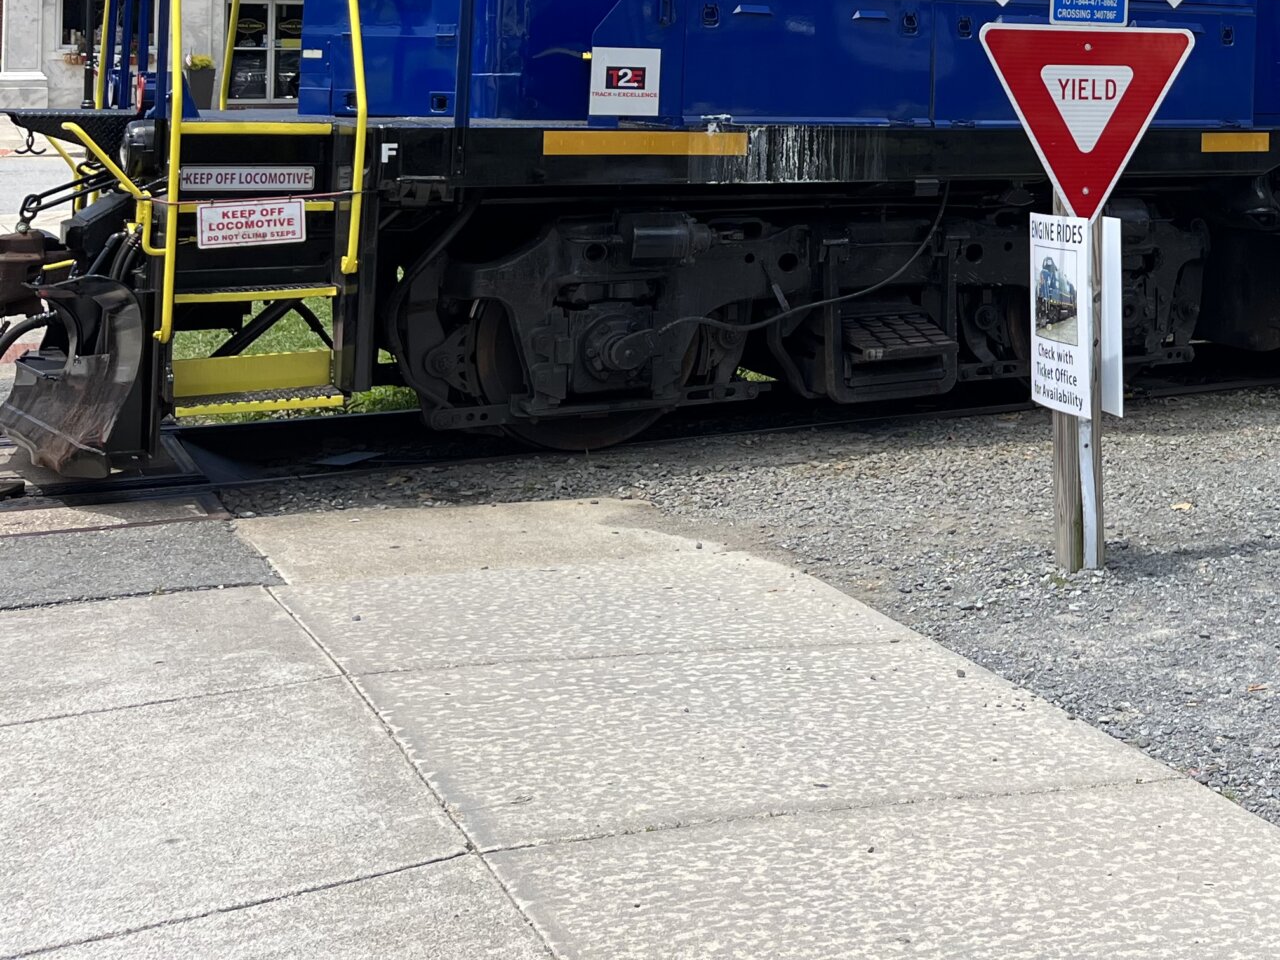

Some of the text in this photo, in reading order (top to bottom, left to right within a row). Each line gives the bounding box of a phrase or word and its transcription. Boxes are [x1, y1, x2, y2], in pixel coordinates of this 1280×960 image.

[1057, 9, 1091, 19] CROSSING
[1058, 78, 1117, 100] YIELD
[381, 143, 398, 163] F
[185, 172, 309, 185] KEEP OFF LOCOMOTIVE
[222, 207, 285, 219] KEEP OFF
[208, 217, 295, 231] LOCOMOTIVE
[1032, 220, 1083, 244] ENGINE RIDES
[222, 233, 239, 241] NOT
[242, 231, 267, 240] CLIMB
[270, 229, 296, 238] STEPS
[1038, 343, 1074, 365] Check with
[1037, 361, 1077, 387] Ticket Office
[1034, 379, 1083, 411] for Availability
